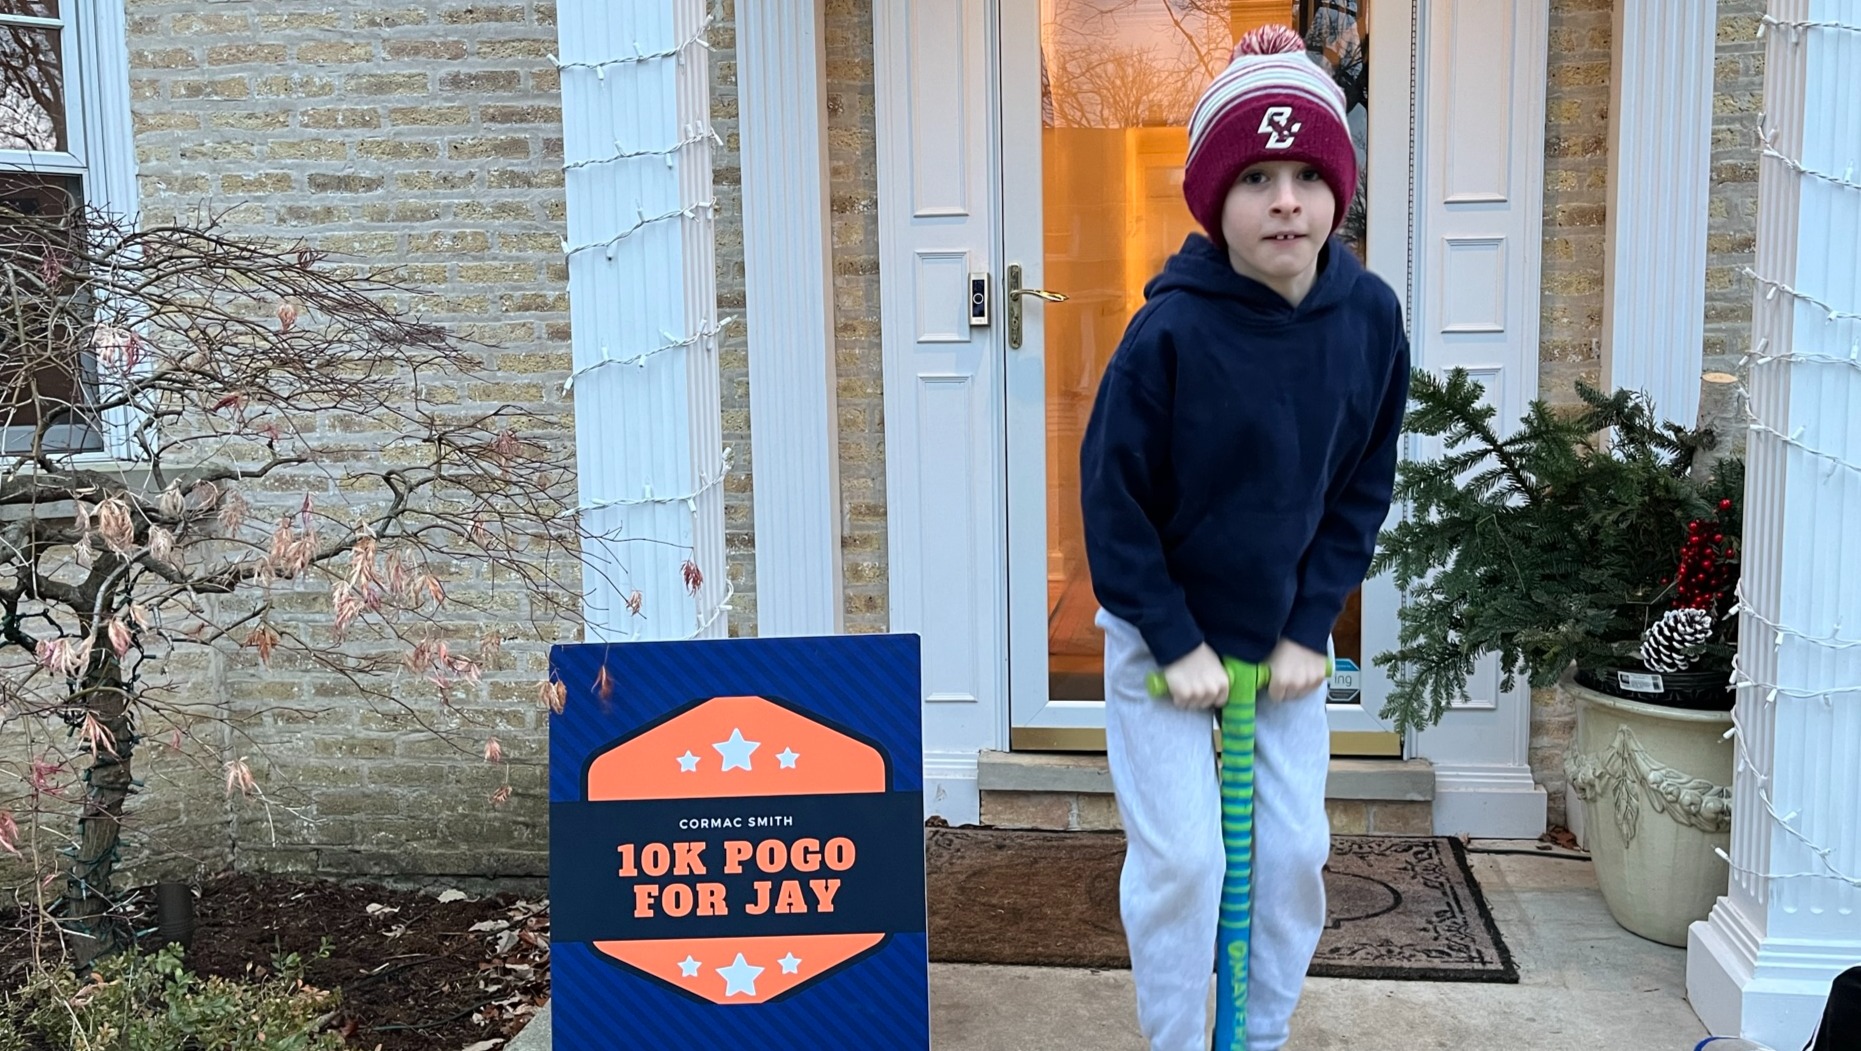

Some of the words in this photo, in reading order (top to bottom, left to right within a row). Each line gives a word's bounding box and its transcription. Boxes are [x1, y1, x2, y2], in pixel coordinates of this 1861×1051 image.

[1334, 674, 1352, 687] ing
[679, 817, 742, 829] CORMAC
[748, 815, 793, 827] SMITH
[617, 841, 707, 877] 10K
[723, 836, 856, 874] POGO
[633, 882, 729, 918] FOR
[745, 878, 841, 915] JAY
